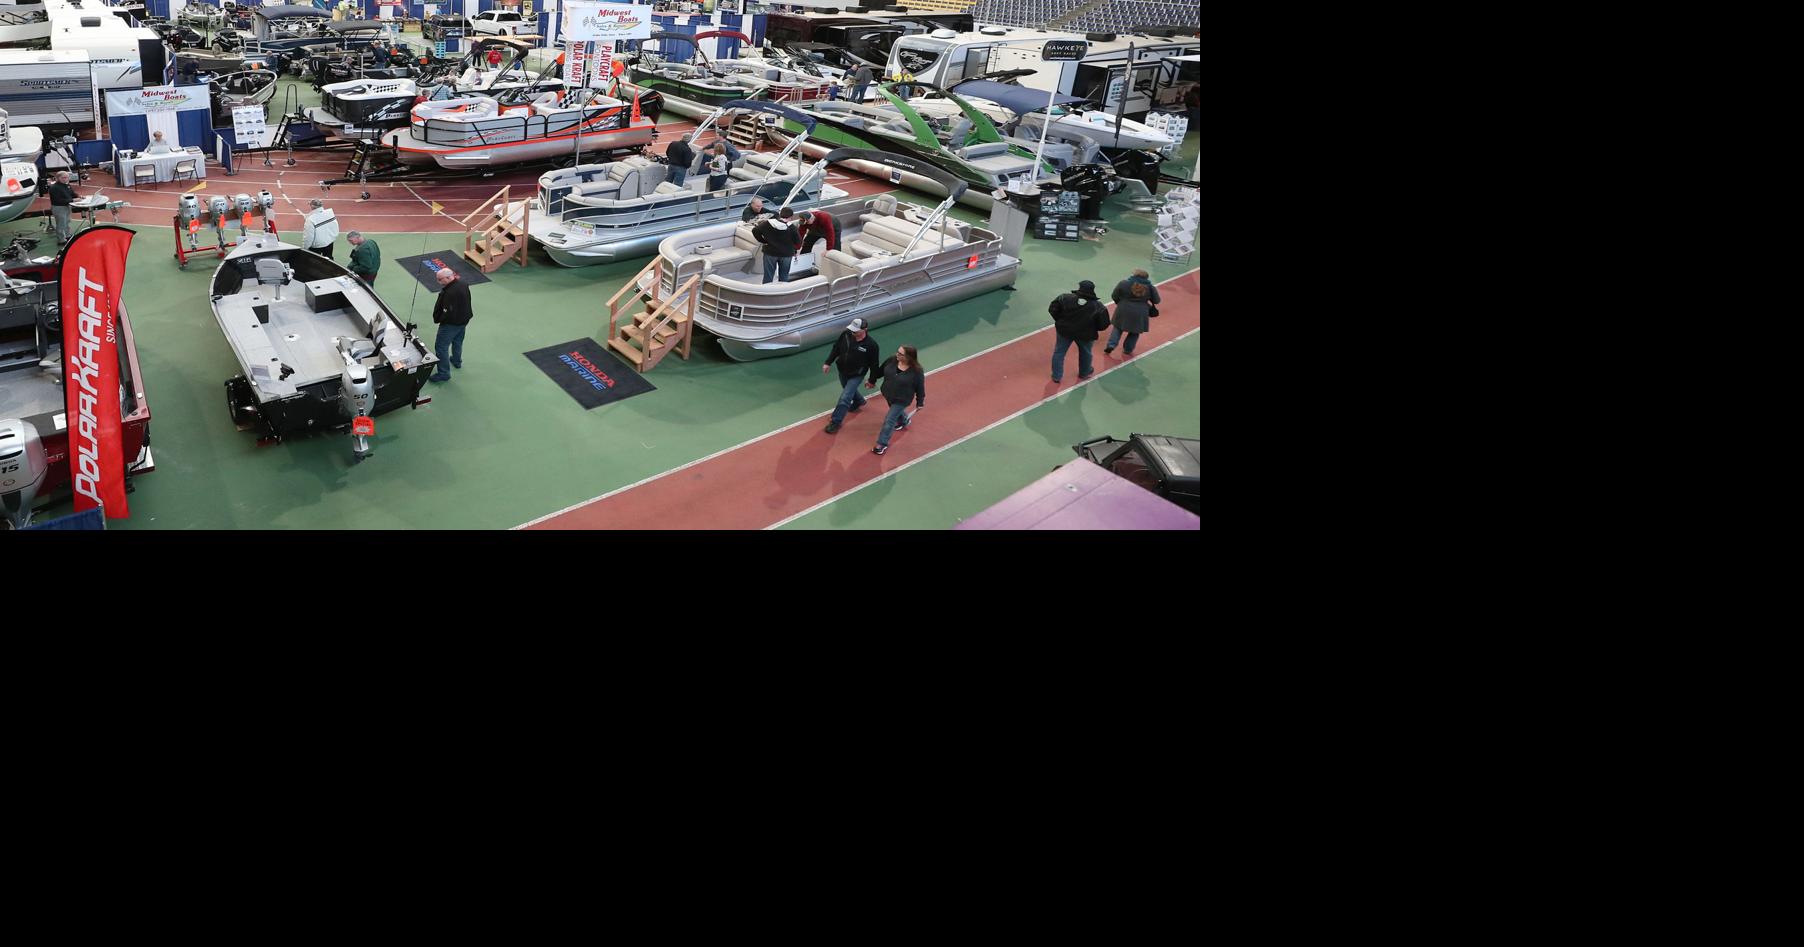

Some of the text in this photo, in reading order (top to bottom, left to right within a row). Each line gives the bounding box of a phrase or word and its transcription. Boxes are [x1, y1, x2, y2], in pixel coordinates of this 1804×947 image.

[598, 9, 632, 17] Midwest
[617, 15, 639, 23] Boats
[592, 44, 601, 81] PONTOONS
[598, 45, 612, 81] PLAYCRAFT
[571, 63, 583, 83] KRAFT
[141, 90, 177, 98] Midwest
[558, 354, 606, 391] MARINE
[569, 351, 617, 388] HONDA
[1, 463, 19, 474] 15
